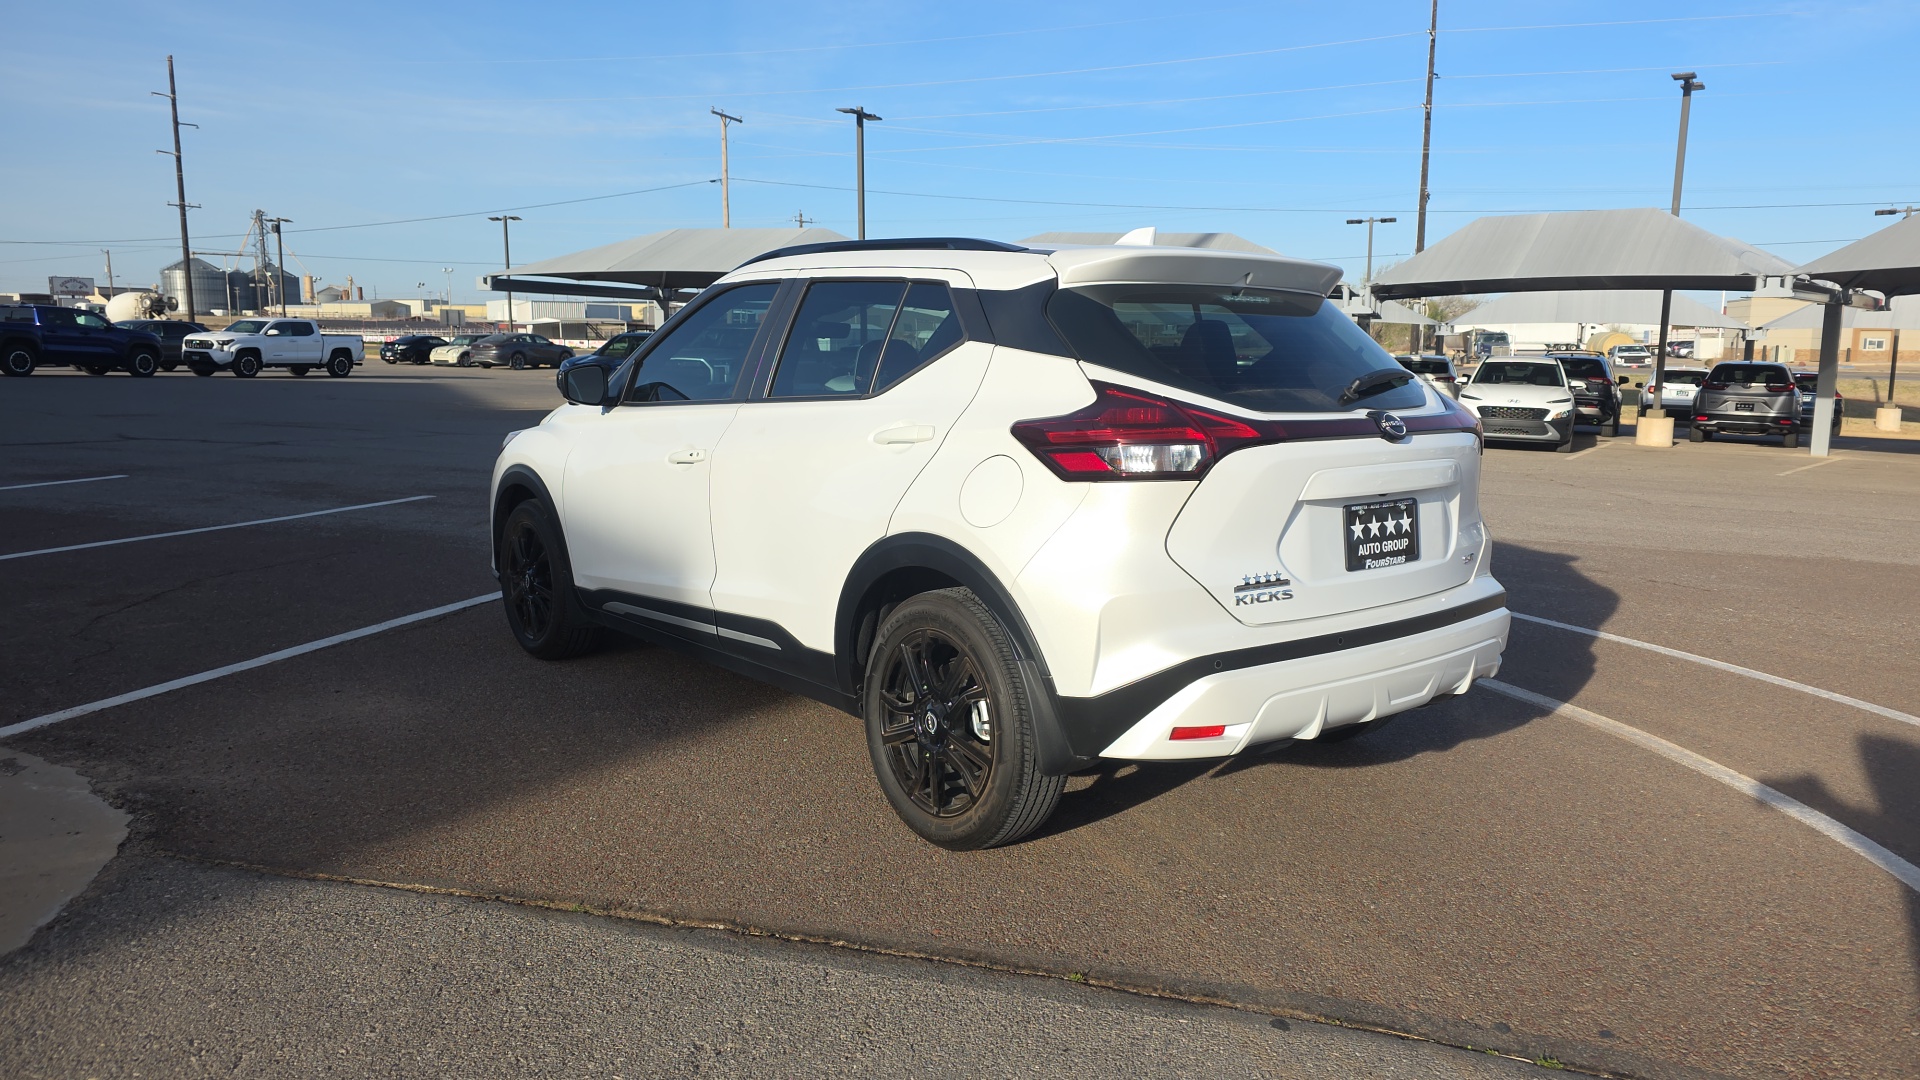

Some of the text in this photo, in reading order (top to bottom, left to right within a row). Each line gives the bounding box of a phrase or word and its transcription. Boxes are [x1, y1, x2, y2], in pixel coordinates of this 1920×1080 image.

[1358, 538, 1409, 556] AUTO GROUP
[1235, 589, 1294, 606] KICKS
